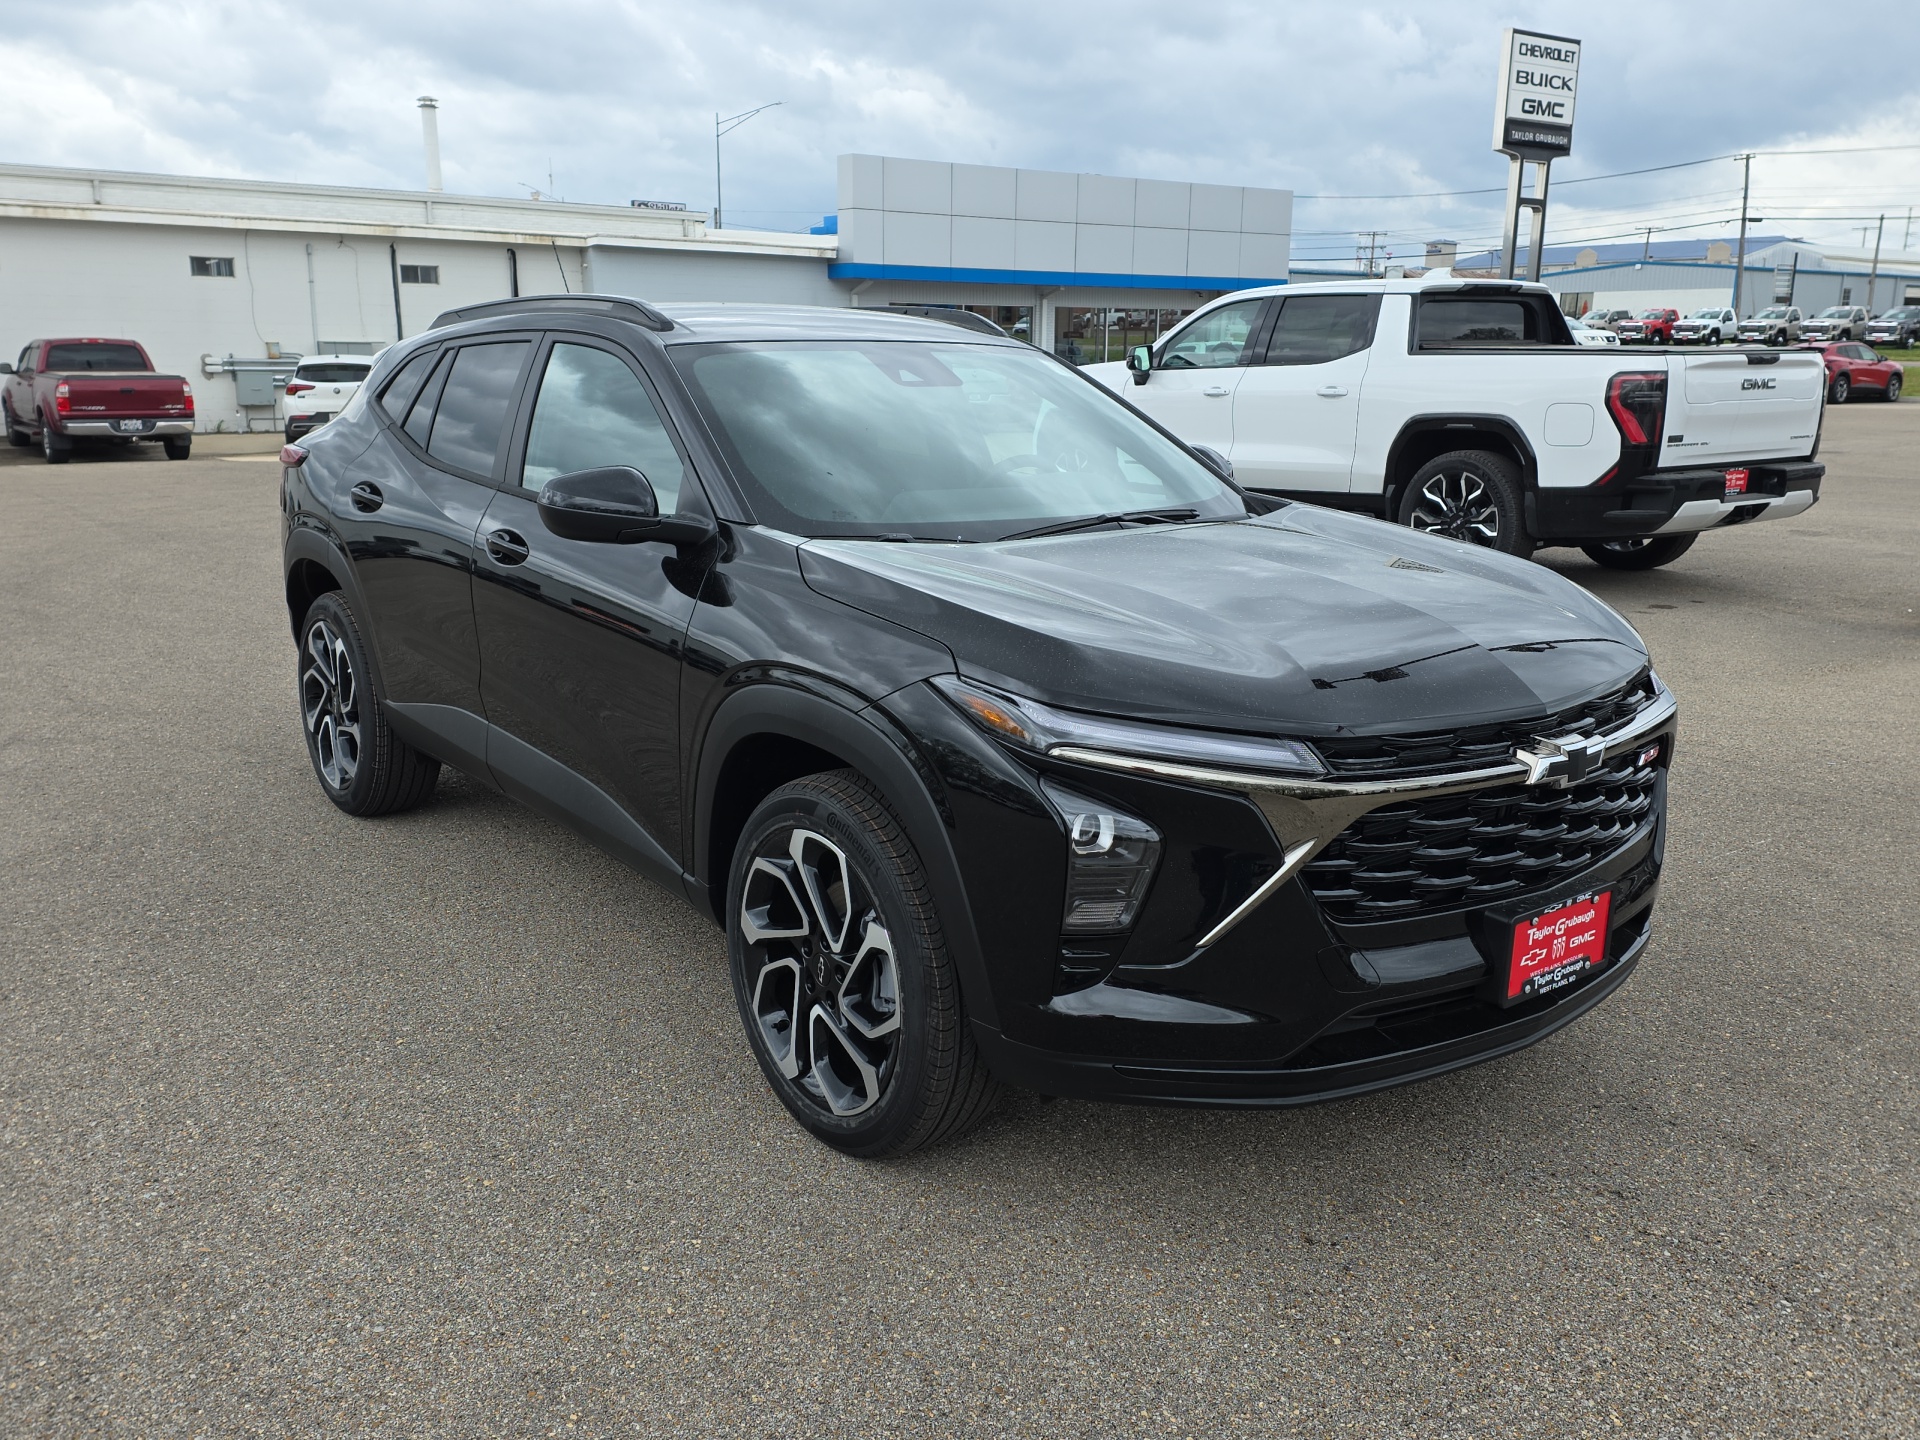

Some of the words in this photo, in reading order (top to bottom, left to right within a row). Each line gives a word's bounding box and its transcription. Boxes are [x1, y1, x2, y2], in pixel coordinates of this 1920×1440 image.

[1519, 42, 1576, 63] CHEVROLET
[1516, 70, 1573, 91] BUICK
[1522, 98, 1565, 118] GMC
[1511, 130, 1534, 141] TAYLOR
[1535, 133, 1568, 145] GRUBAUGH
[1741, 377, 1777, 391] GMC
[827, 812, 875, 867] Continental
[1576, 892, 1592, 902] GMC
[1527, 926, 1556, 946] Taylor
[1555, 909, 1596, 936] Grubaugh
[1570, 930, 1595, 947] GMC
[1533, 974, 1554, 989] Taylor
[1554, 960, 1583, 980] Grubaugh
